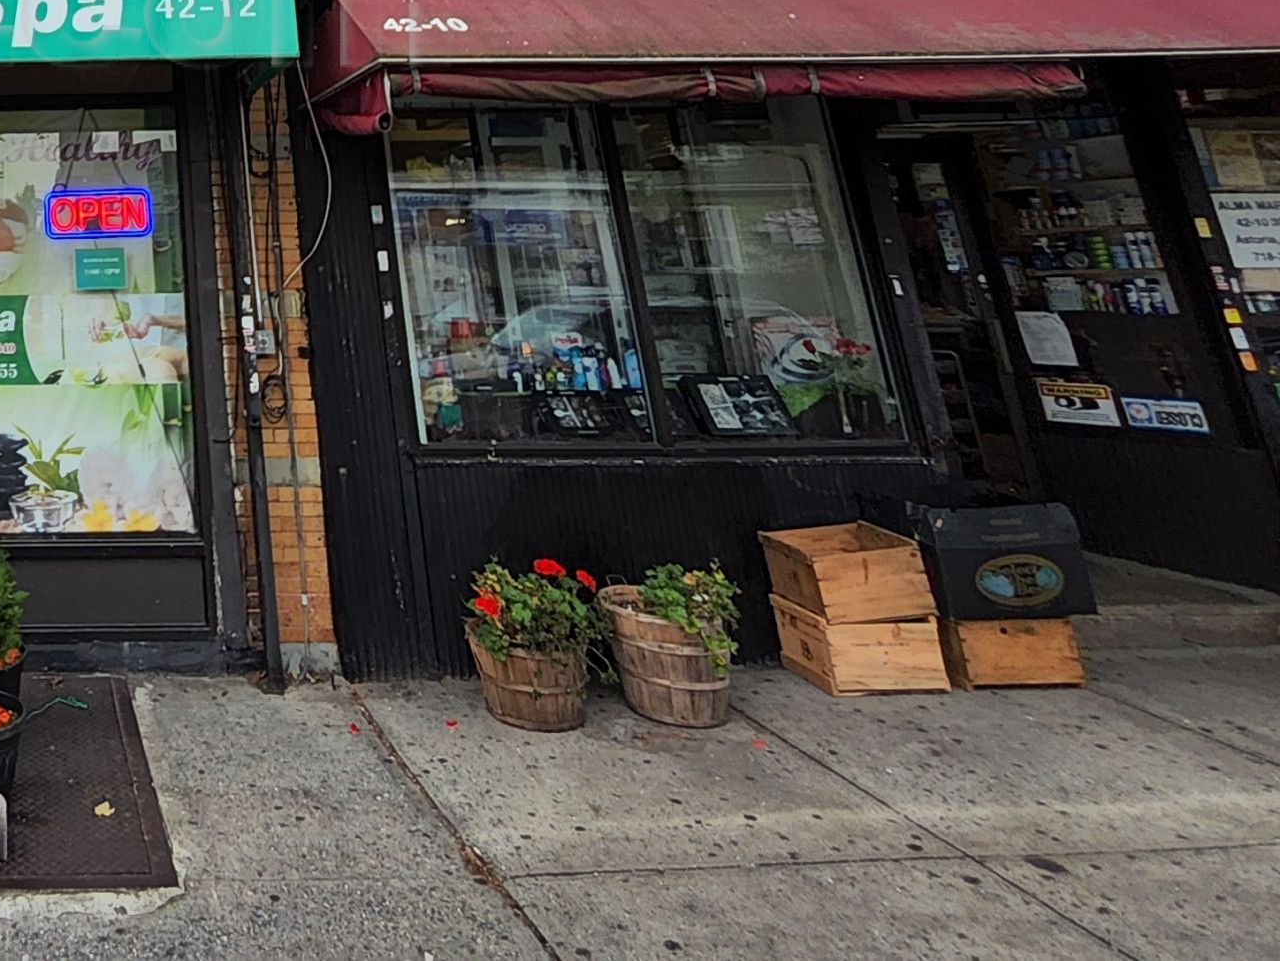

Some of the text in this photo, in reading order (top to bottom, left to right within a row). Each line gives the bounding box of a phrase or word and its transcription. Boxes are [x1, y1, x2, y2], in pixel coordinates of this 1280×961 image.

[383, 16, 468, 33] 42-10
[50, 194, 147, 232] OPEN
[1046, 387, 1104, 398] WARNING
